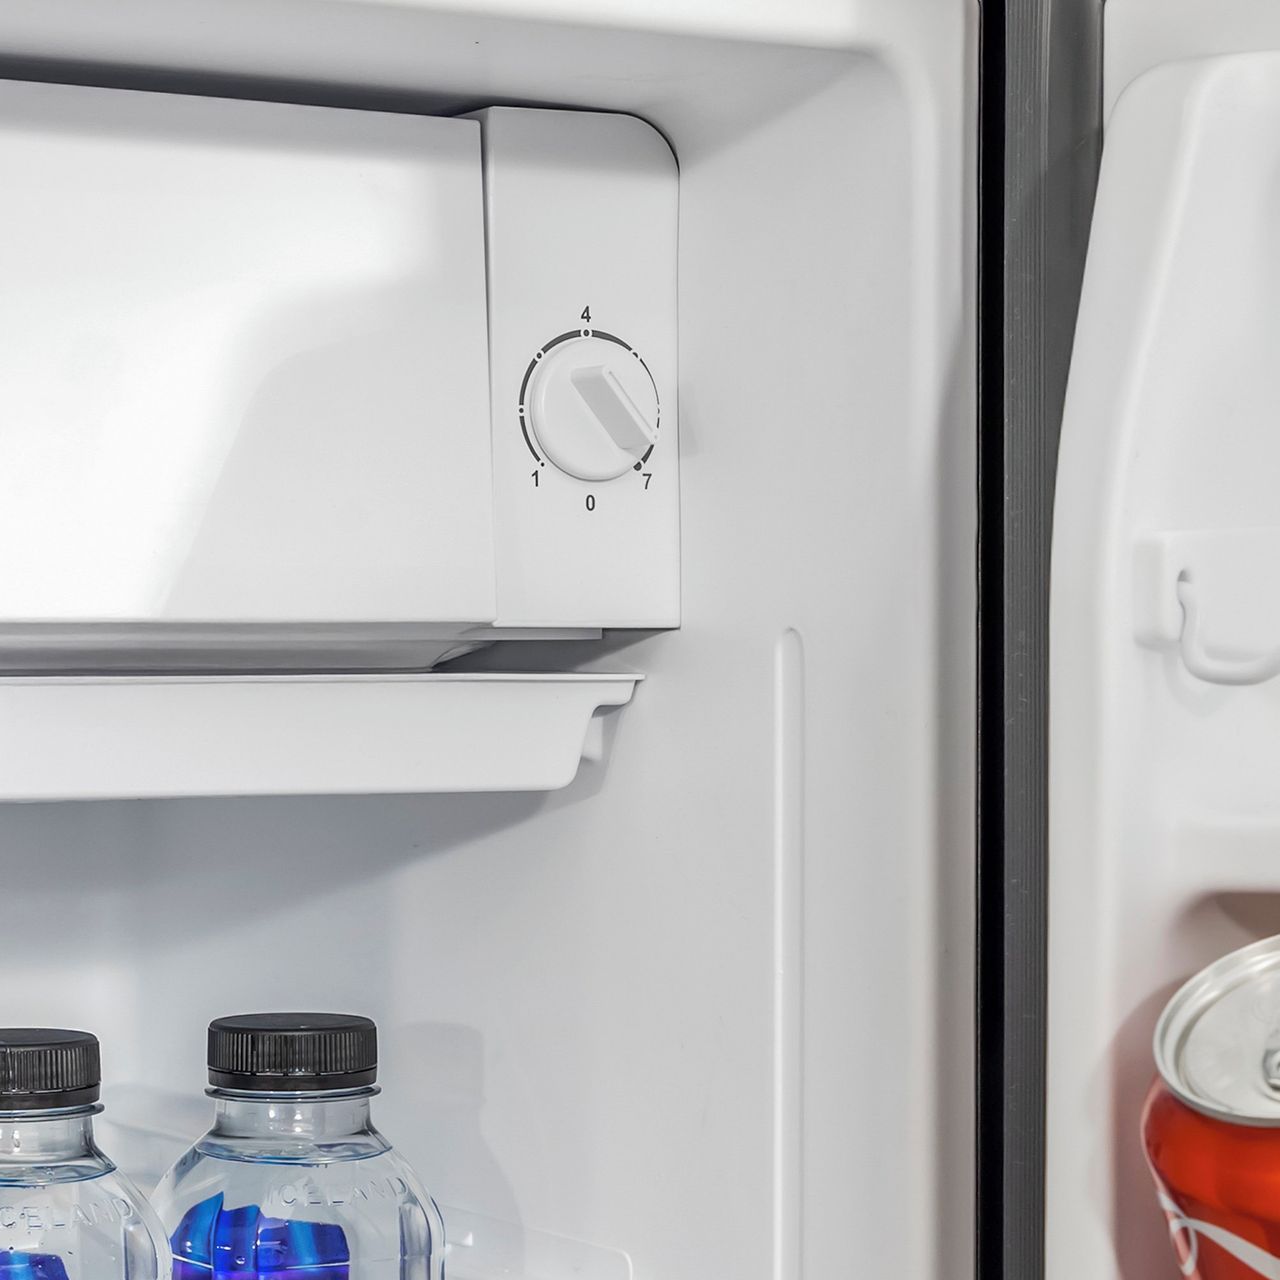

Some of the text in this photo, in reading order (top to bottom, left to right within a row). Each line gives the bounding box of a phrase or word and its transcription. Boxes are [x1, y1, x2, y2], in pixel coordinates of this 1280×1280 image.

[580, 305, 592, 323] 4
[531, 470, 539, 487] 1
[642, 473, 652, 490] 7
[585, 494, 596, 512] 0
